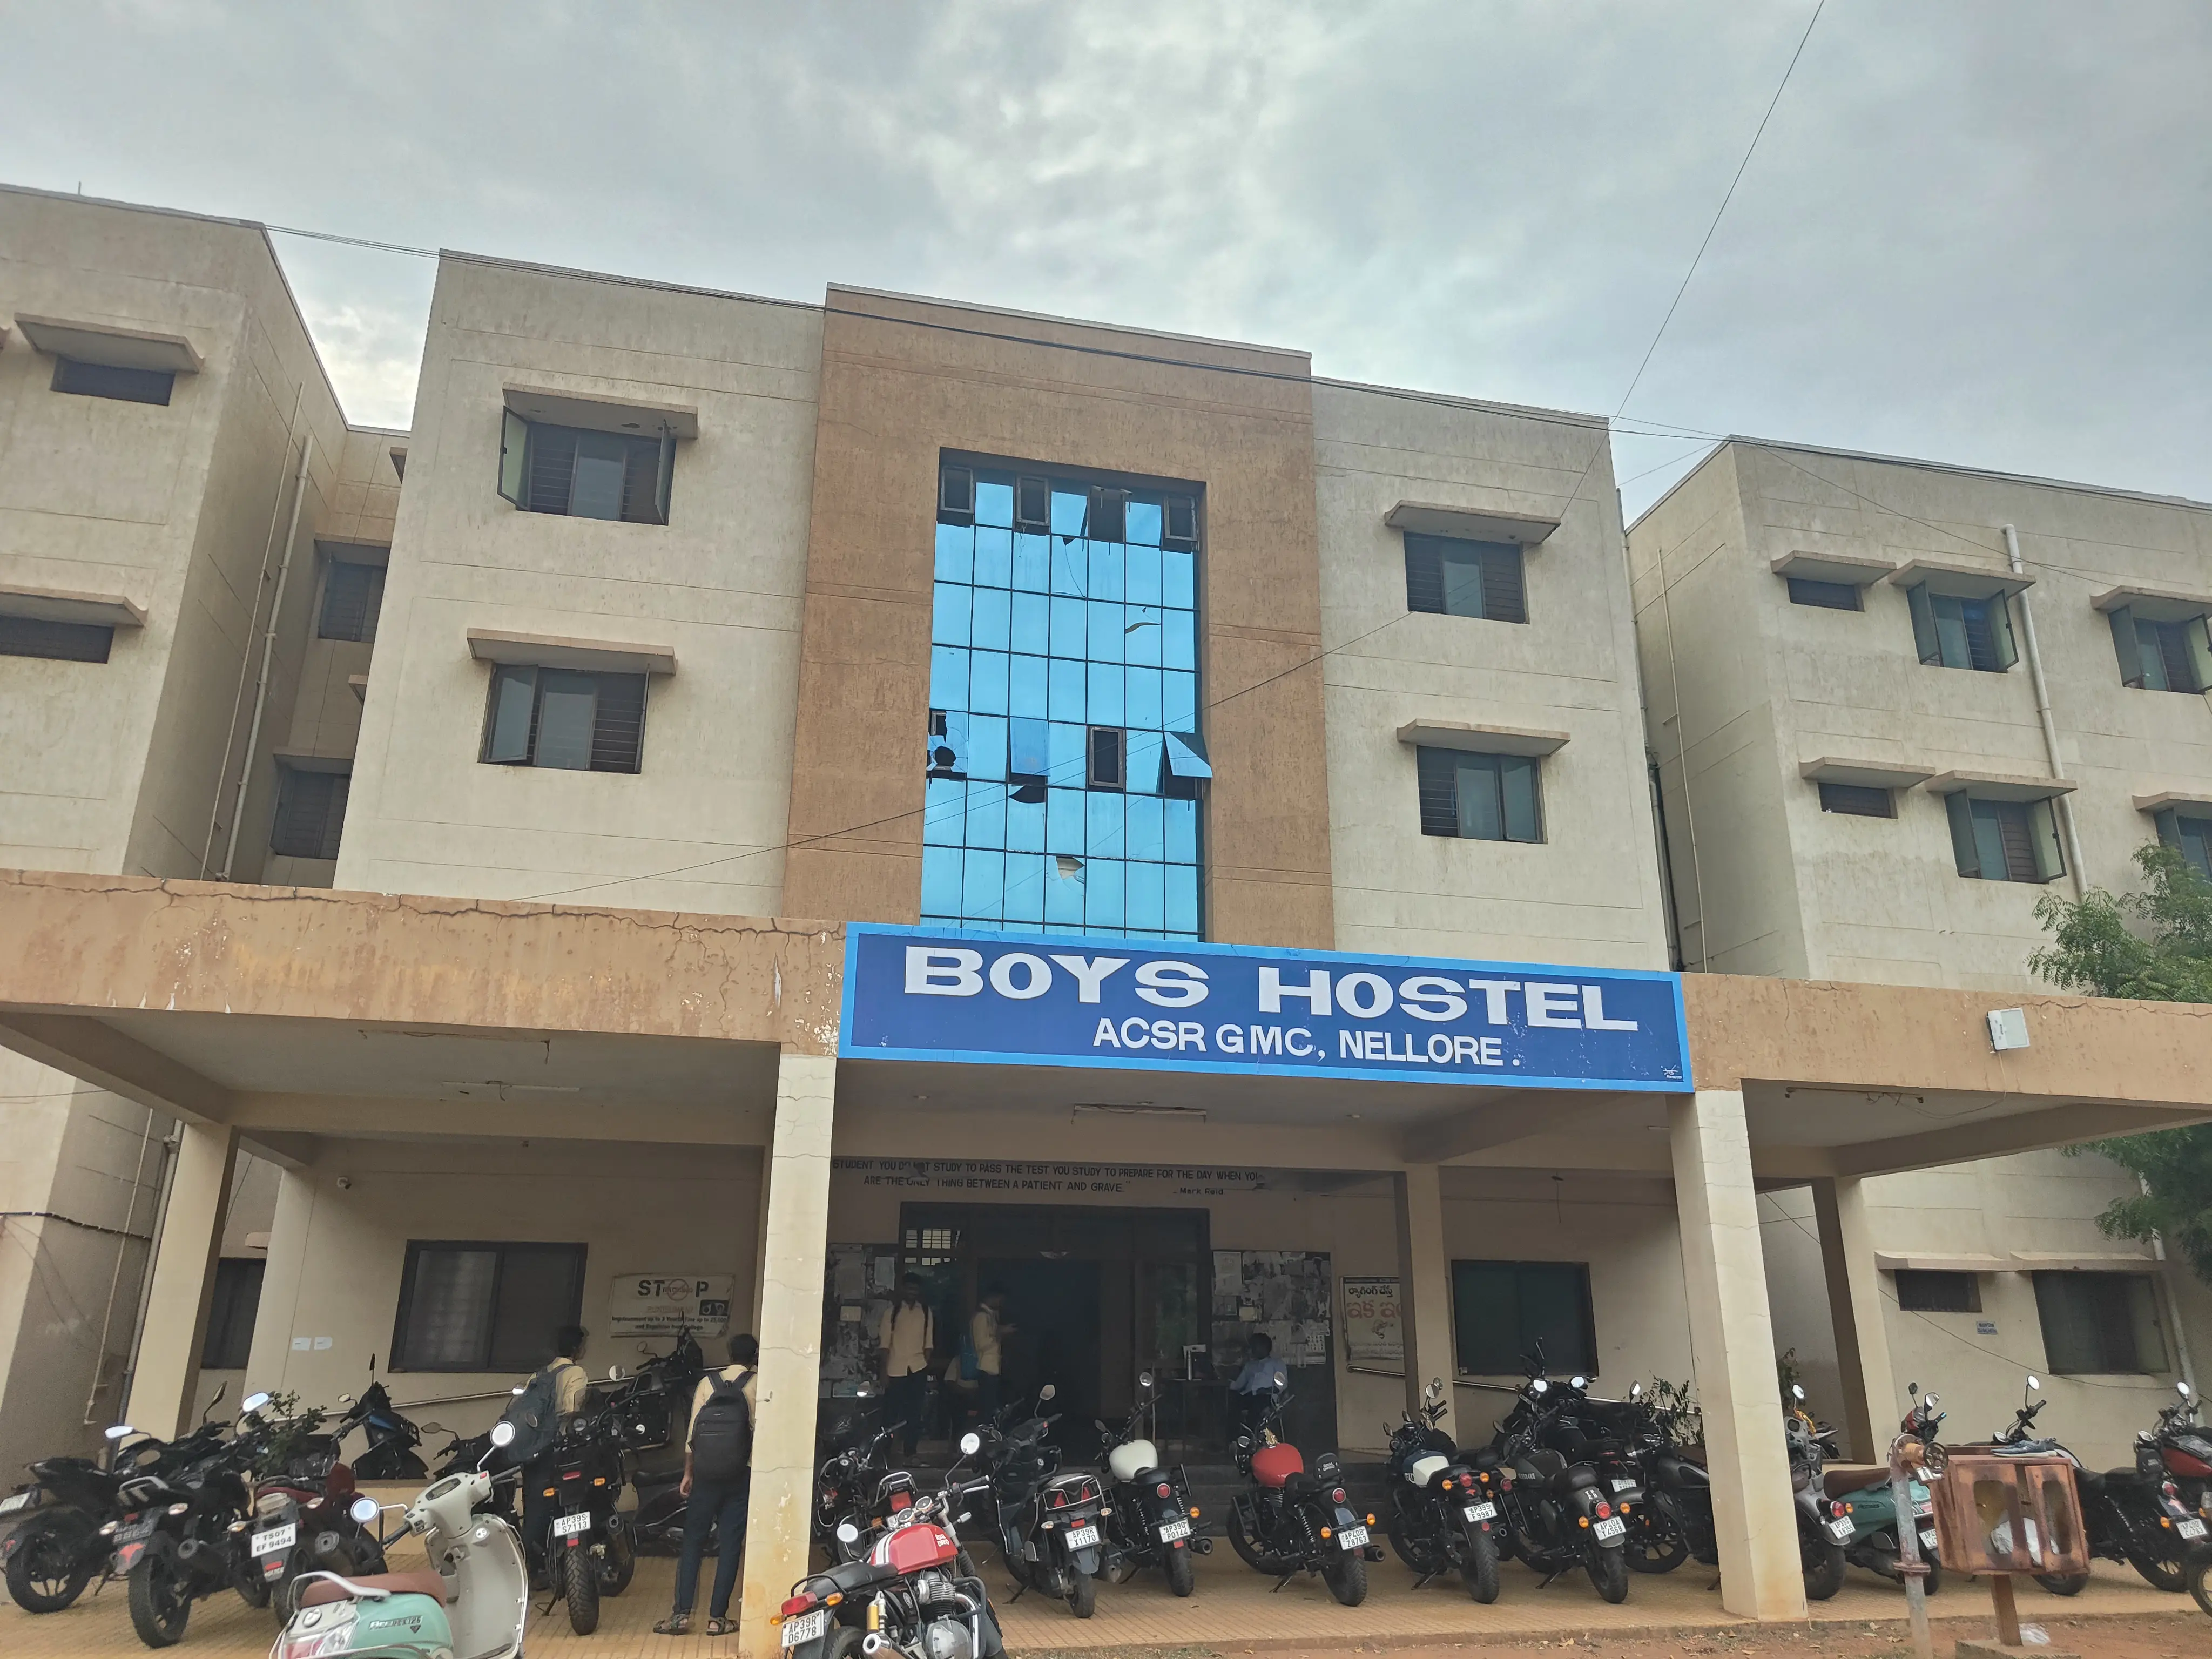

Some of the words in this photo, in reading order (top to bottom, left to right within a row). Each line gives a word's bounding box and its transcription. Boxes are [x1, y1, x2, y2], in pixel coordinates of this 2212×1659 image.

[905, 946, 1209, 1008] BOYS
[1258, 967, 1638, 1032] HOSTEL
[1093, 1017, 1208, 1053] ACSR
[1216, 1025, 1325, 1063] GMC,
[833, 1159, 874, 1170] STUDENT
[879, 1161, 896, 1171] YOU
[933, 1162, 963, 1172] STUDY
[965, 1163, 977, 1172] TO
[980, 1164, 1002, 1174] PASS
[1006, 1164, 1023, 1174] THE
[1026, 1165, 1050, 1175] TEST
[1053, 1166, 1070, 1176] YOU
[1072, 1166, 1102, 1177] STUDY
[1104, 1168, 1117, 1177] TO
[1118, 1168, 1154, 1178] PREPARE
[1157, 1169, 1174, 1179] FOR
[1176, 1170, 1194, 1179] THE
[1197, 1170, 1213, 1180] DAY
[1216, 1171, 1241, 1181] WHEN
[864, 1176, 881, 1185] ARE
[886, 1176, 904, 1186] THE
[967, 1178, 1010, 1189] BETWEEN
[1012, 1179, 1019, 1189] A
[1022, 1179, 1063, 1191] PATIENT
[1067, 1181, 1087, 1191] AND
[1470, 1503, 1491, 1514] AP39S
[562, 1514, 586, 1526] AP39S
[1600, 1519, 1620, 1530] AP40A
[562, 1521, 587, 1533] S7113
[1072, 1527, 1094, 1539] AP39R
[262, 1529, 286, 1541] TS07
[1074, 1534, 1096, 1546] X1170
[1167, 1528, 1188, 1540] P0144
[1345, 1528, 1364, 1541] AP40B
[1346, 1535, 1367, 1547] Z8763
[788, 1615, 817, 1634] AP39R
[788, 1626, 817, 1644] D6778
